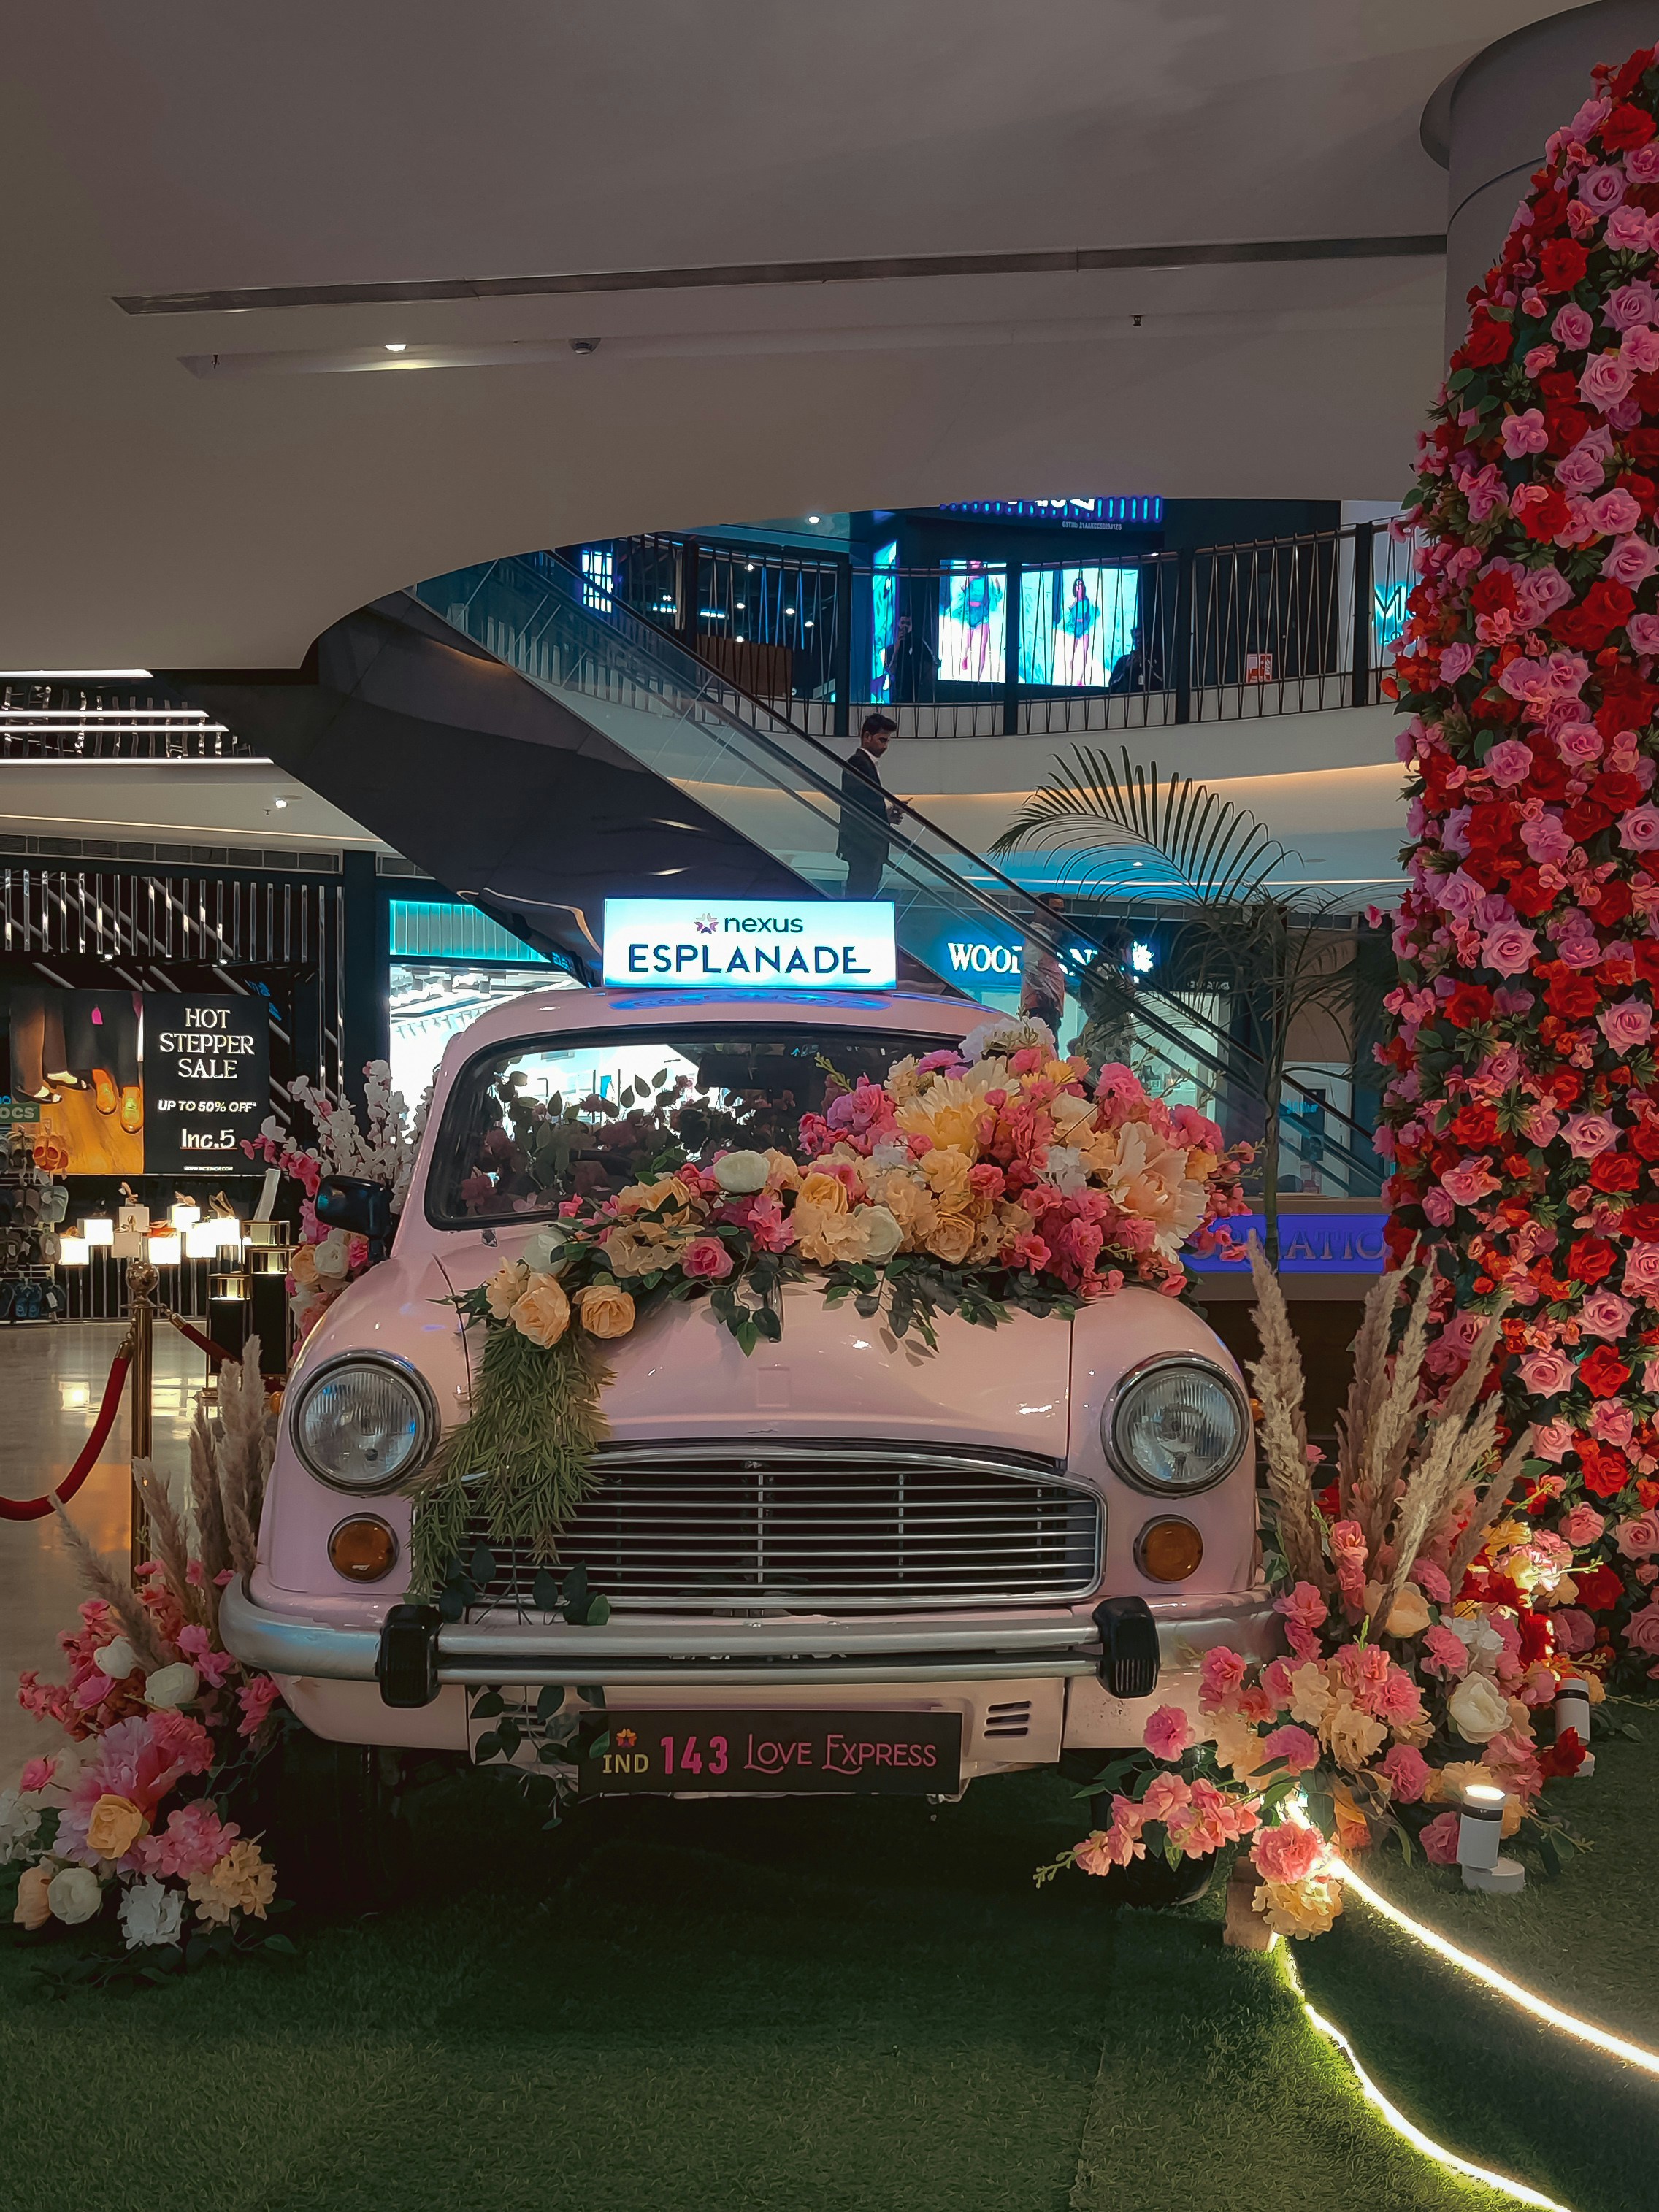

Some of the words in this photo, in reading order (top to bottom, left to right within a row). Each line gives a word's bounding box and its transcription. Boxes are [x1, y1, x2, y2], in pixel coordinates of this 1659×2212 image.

[724, 916, 803, 934] nexus
[629, 944, 871, 974] ESPLANADE
[185, 1007, 231, 1029] HOT
[159, 1032, 256, 1056] STEPPER
[177, 1059, 238, 1079] SALE
[158, 1099, 177, 1111] UP
[178, 1100, 196, 1112] TO
[198, 1102, 226, 1113] 50%
[181, 1128, 236, 1149] Inc.5
[602, 1754, 650, 1774] IND
[660, 1735, 729, 1775] 143
